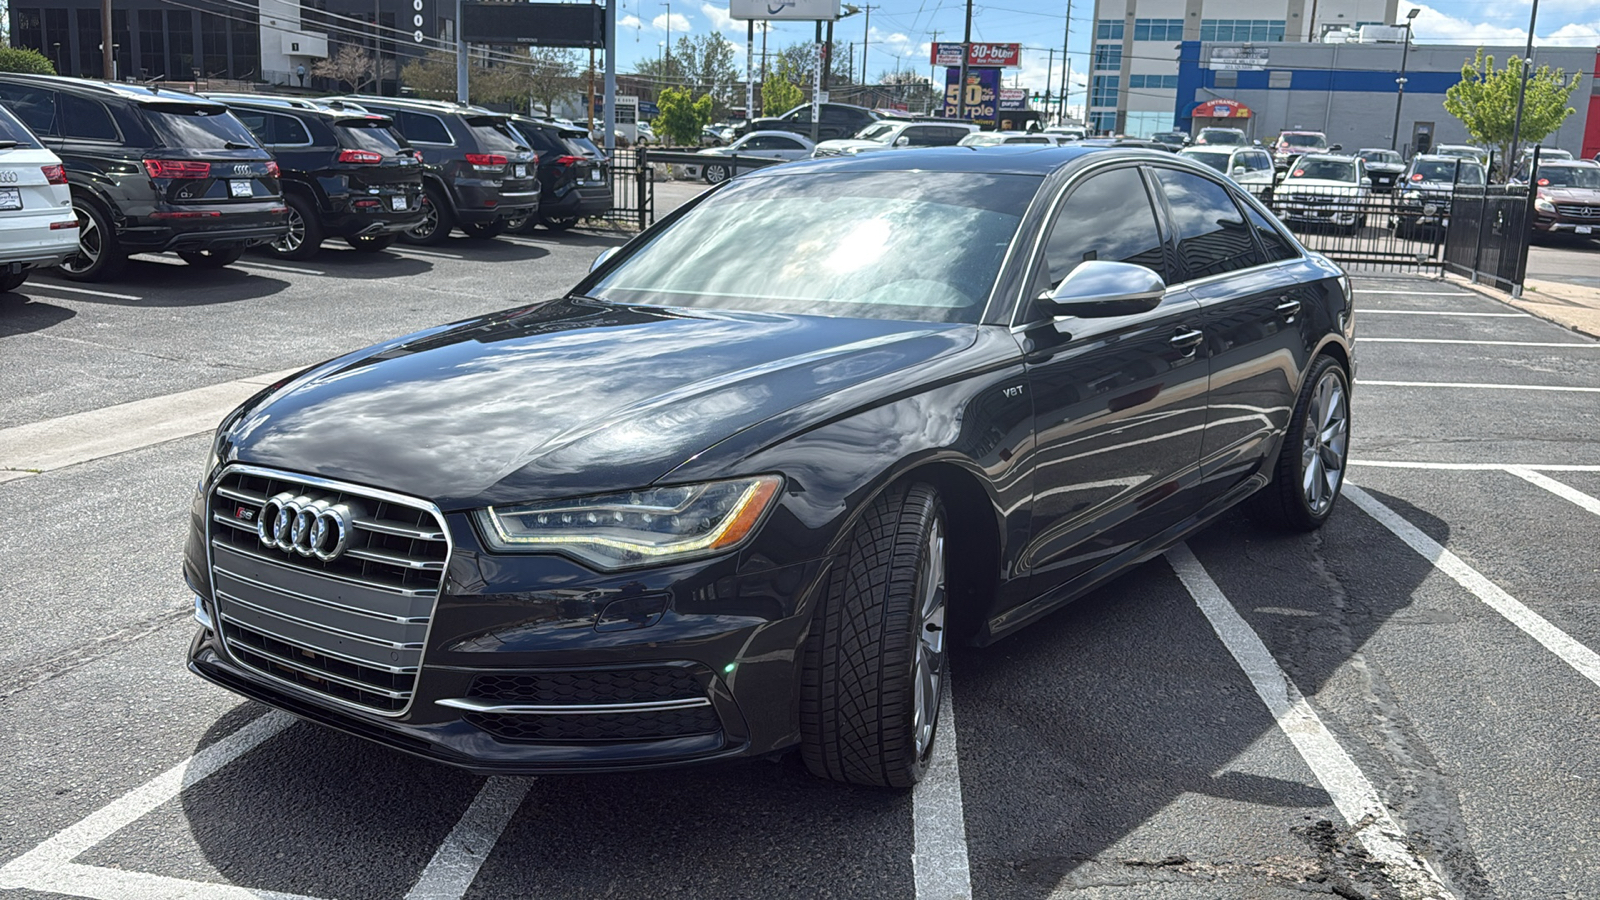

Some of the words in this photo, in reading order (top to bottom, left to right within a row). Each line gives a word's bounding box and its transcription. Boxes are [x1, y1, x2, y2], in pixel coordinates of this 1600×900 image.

[946, 84, 982, 105] 50
[1206, 99, 1238, 107] ENTRANCE
[945, 104, 994, 118] prple
[1002, 384, 1023, 398] V8T
